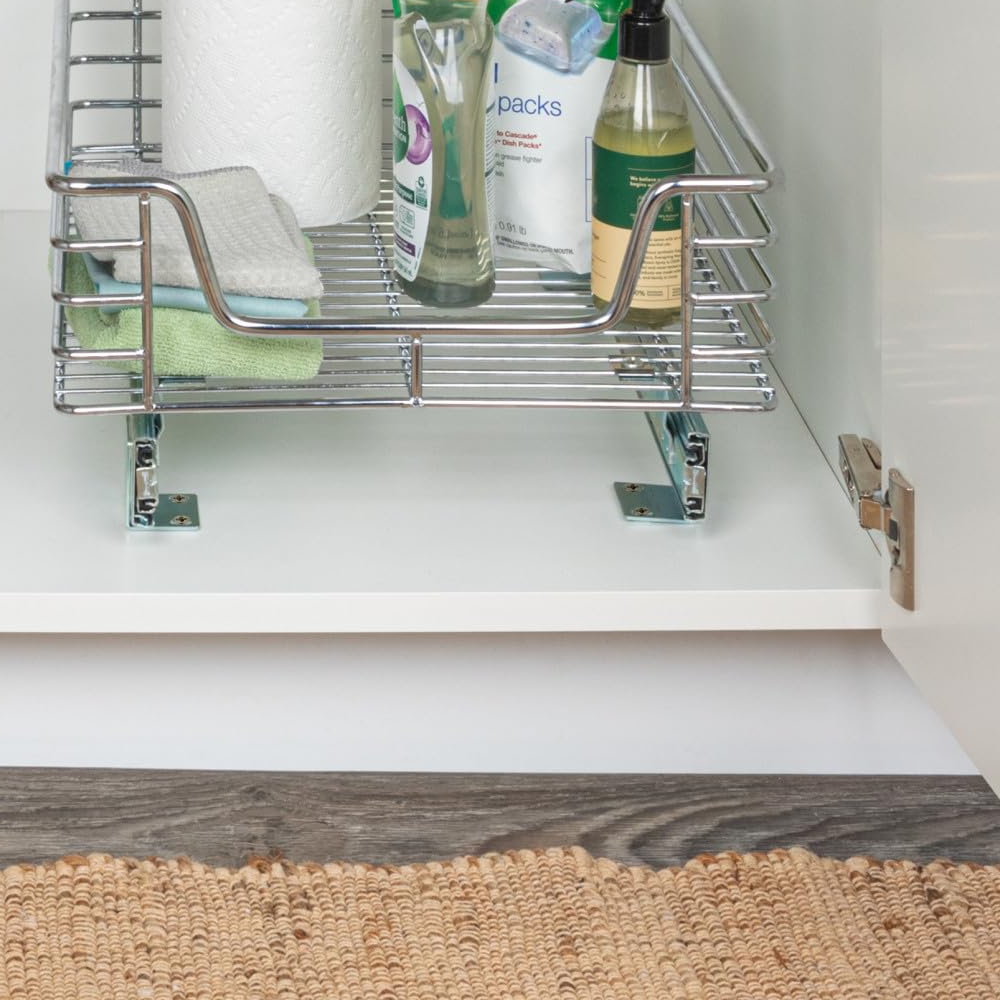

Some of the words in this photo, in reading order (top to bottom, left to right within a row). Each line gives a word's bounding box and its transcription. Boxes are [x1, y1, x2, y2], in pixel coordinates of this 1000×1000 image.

[497, 95, 562, 117] packs
[502, 139, 517, 147] Dish
[522, 155, 542, 163] fighter
